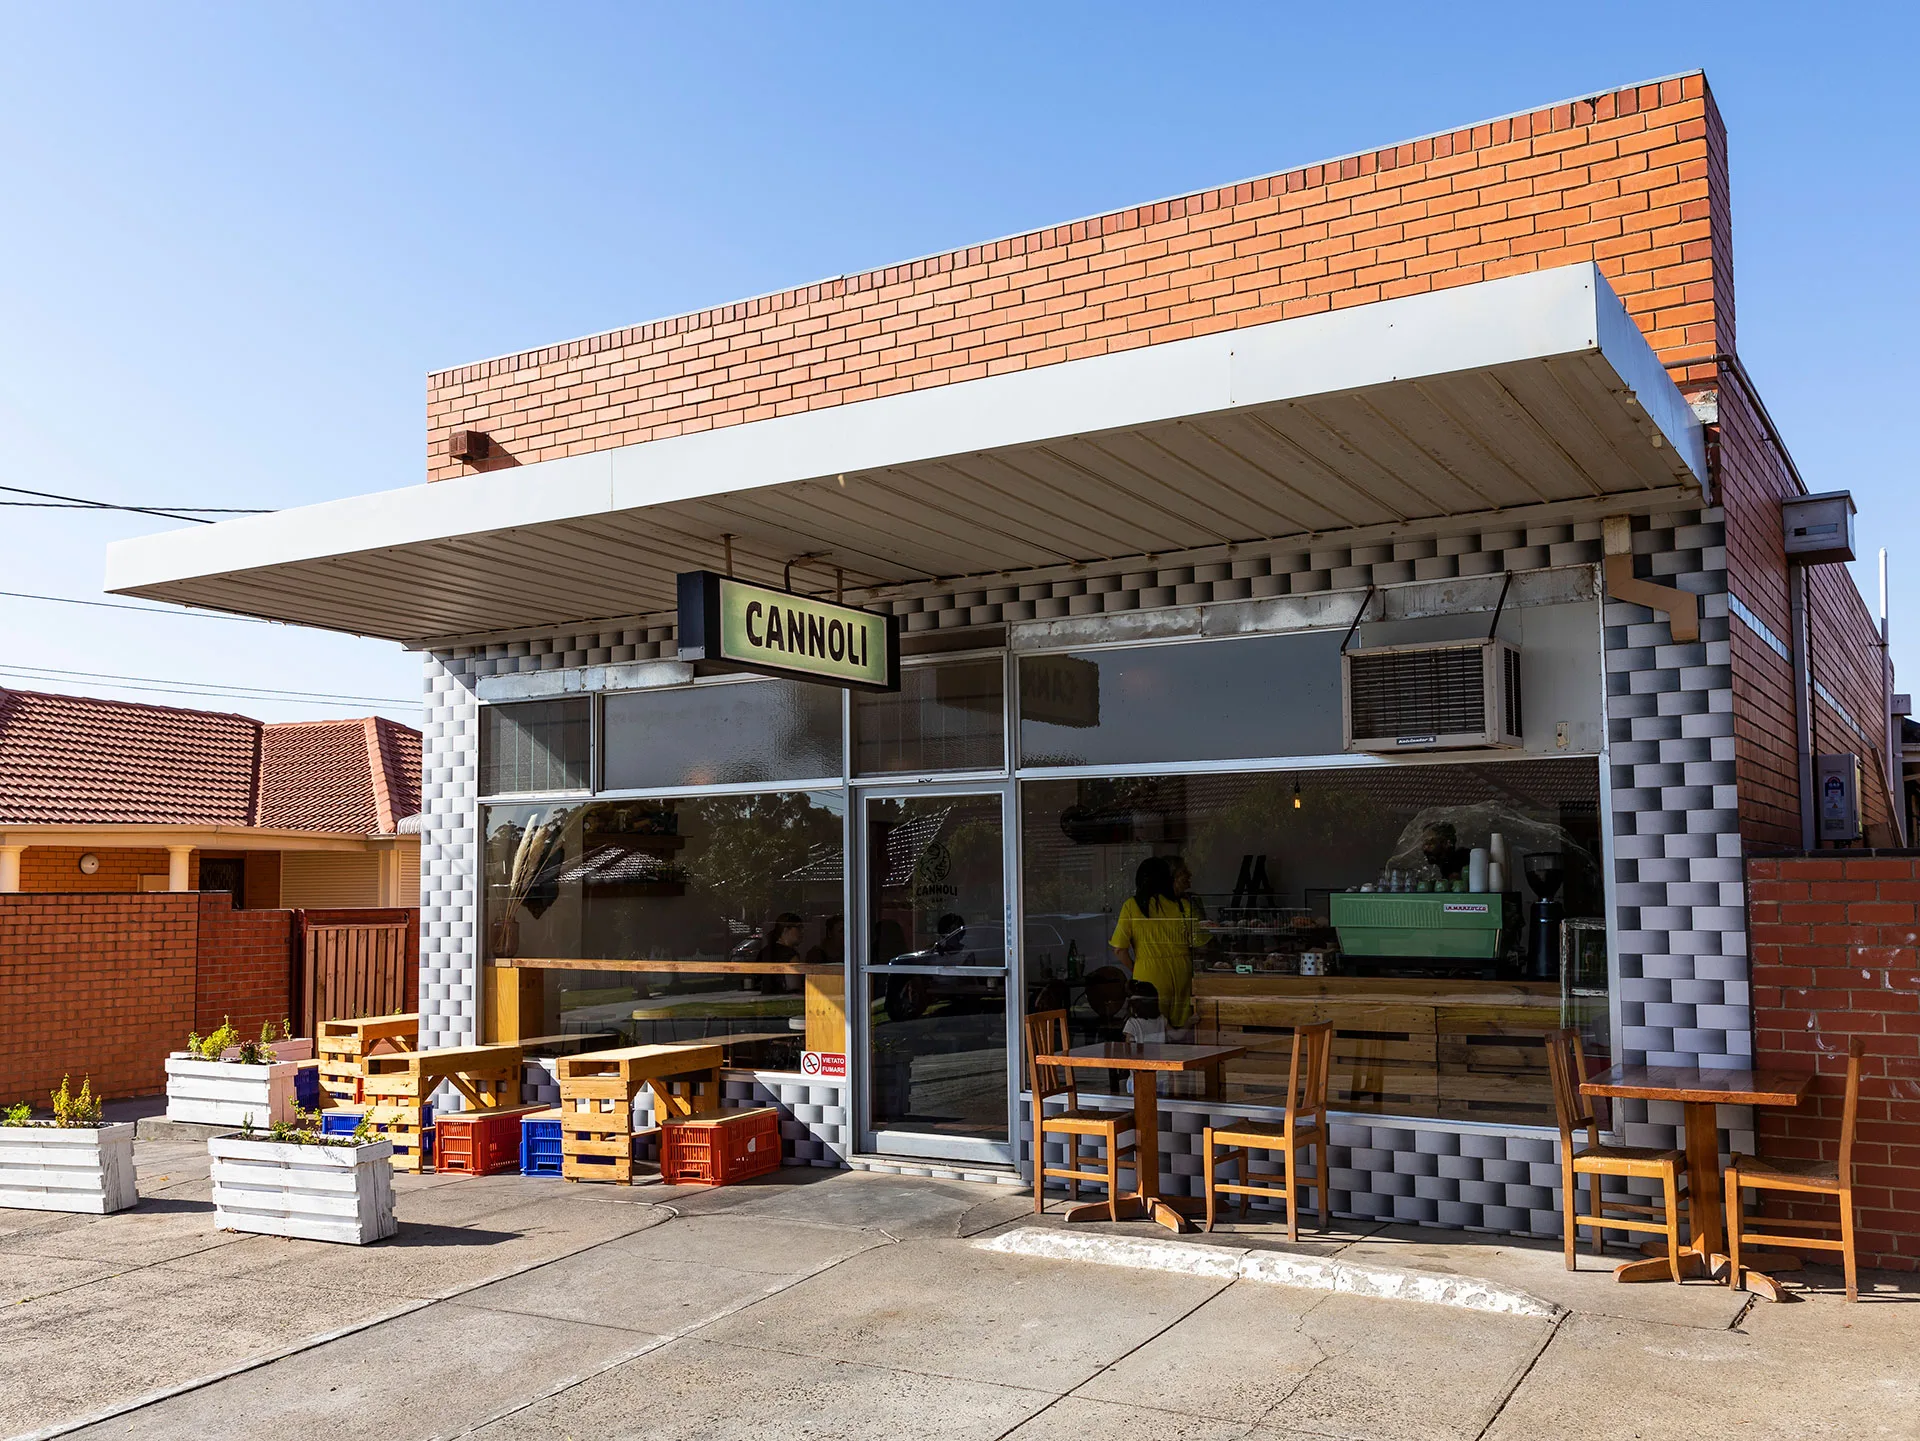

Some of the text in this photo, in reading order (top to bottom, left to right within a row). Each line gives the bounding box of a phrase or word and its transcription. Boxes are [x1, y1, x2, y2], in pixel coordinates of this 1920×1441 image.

[746, 601, 867, 667] CANNOLI
[916, 884, 958, 897] CANNOLI
[822, 1057, 845, 1065] VIETATO
[822, 1065, 845, 1073] FUMARE
